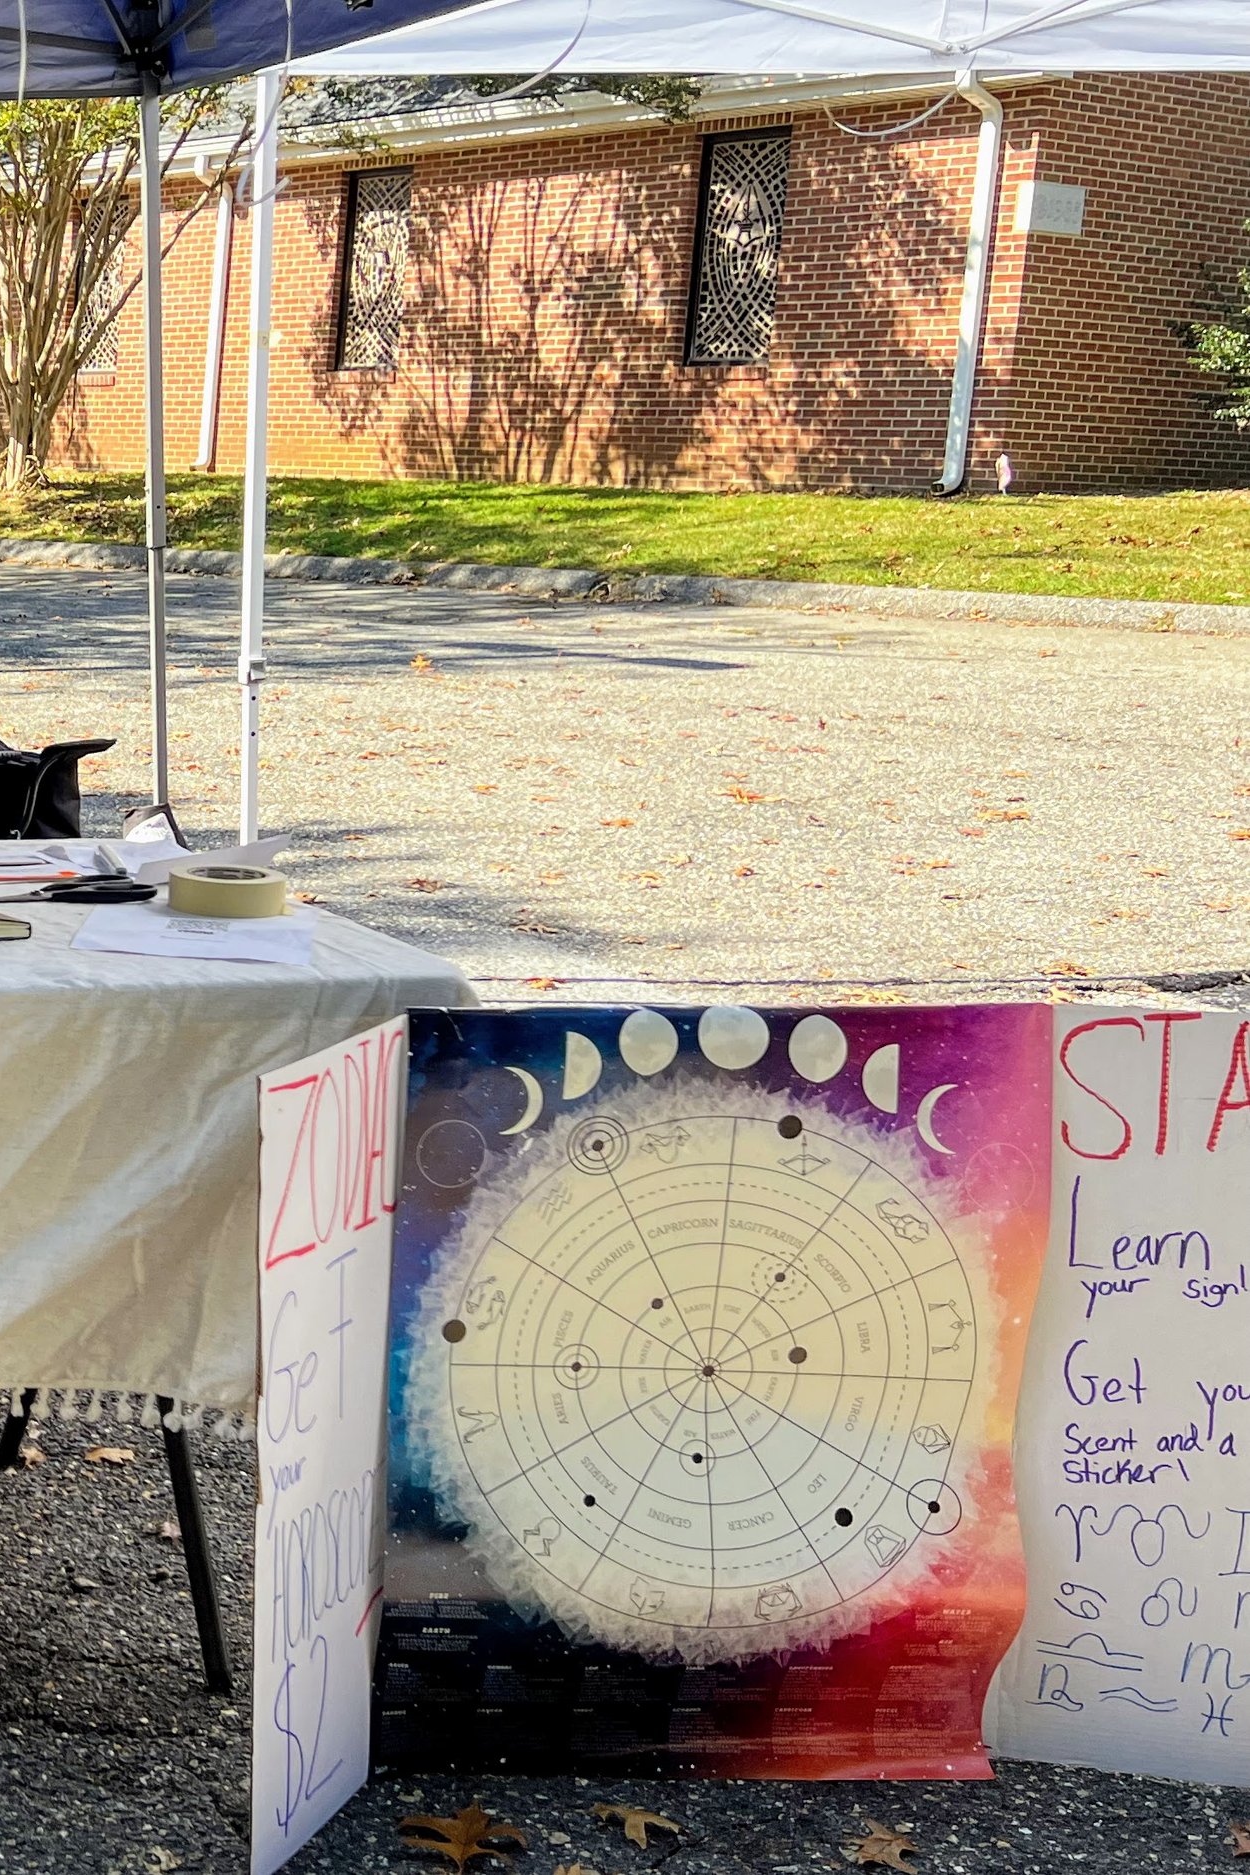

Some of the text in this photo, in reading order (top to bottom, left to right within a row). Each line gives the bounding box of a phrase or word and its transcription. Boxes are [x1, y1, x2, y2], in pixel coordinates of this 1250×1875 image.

[647, 1217, 719, 1240] CAPRICORN
[728, 1218, 804, 1249] SAGITTARIUS
[1069, 1175, 1210, 1270] Learn
[585, 1240, 636, 1286] AQUARIUS
[813, 1253, 851, 1294] SCORPIO
[1081, 1264, 1248, 1318] your sign!
[552, 1310, 574, 1349] PISCES
[856, 1320, 871, 1354] LIBRA
[1064, 1339, 1147, 1405] Get
[551, 1391, 570, 1426] ARIES
[844, 1396, 864, 1433] VIRGO
[1064, 1422, 1237, 1456] Scent and a
[580, 1455, 619, 1496] TAURUS
[807, 1473, 828, 1495] LEO
[647, 1507, 692, 1530] GEMINI
[726, 1511, 775, 1532] CANCER
[942, 1608, 972, 1616] WATER
[421, 1626, 451, 1634] EARTH
[273, 1631, 344, 1838] $2
